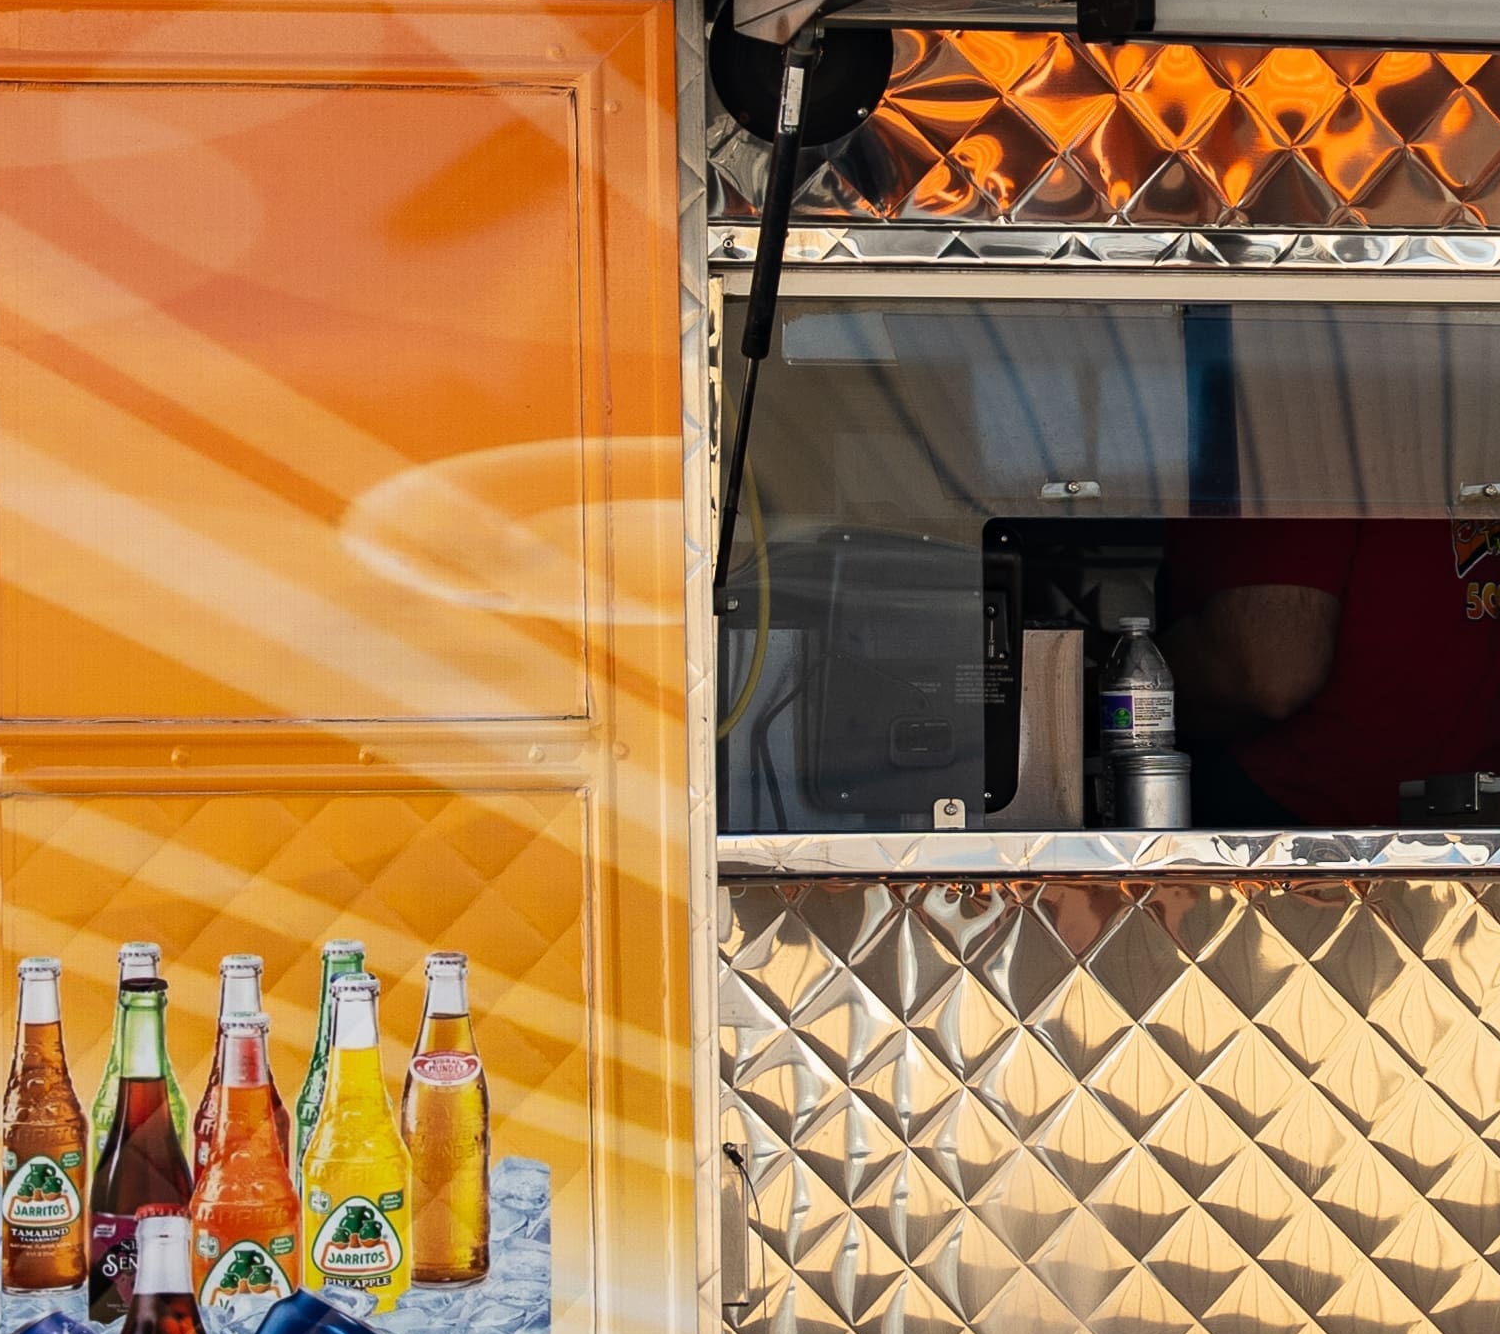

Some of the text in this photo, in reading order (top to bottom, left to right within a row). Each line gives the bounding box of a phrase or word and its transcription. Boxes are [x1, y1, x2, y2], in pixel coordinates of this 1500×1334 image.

[13, 1205, 67, 1217] JARRITOS
[11, 1228, 69, 1237] TAMARIND
[327, 1250, 386, 1265] JARRITOS
[323, 1276, 392, 1288] PINEAPPLE
